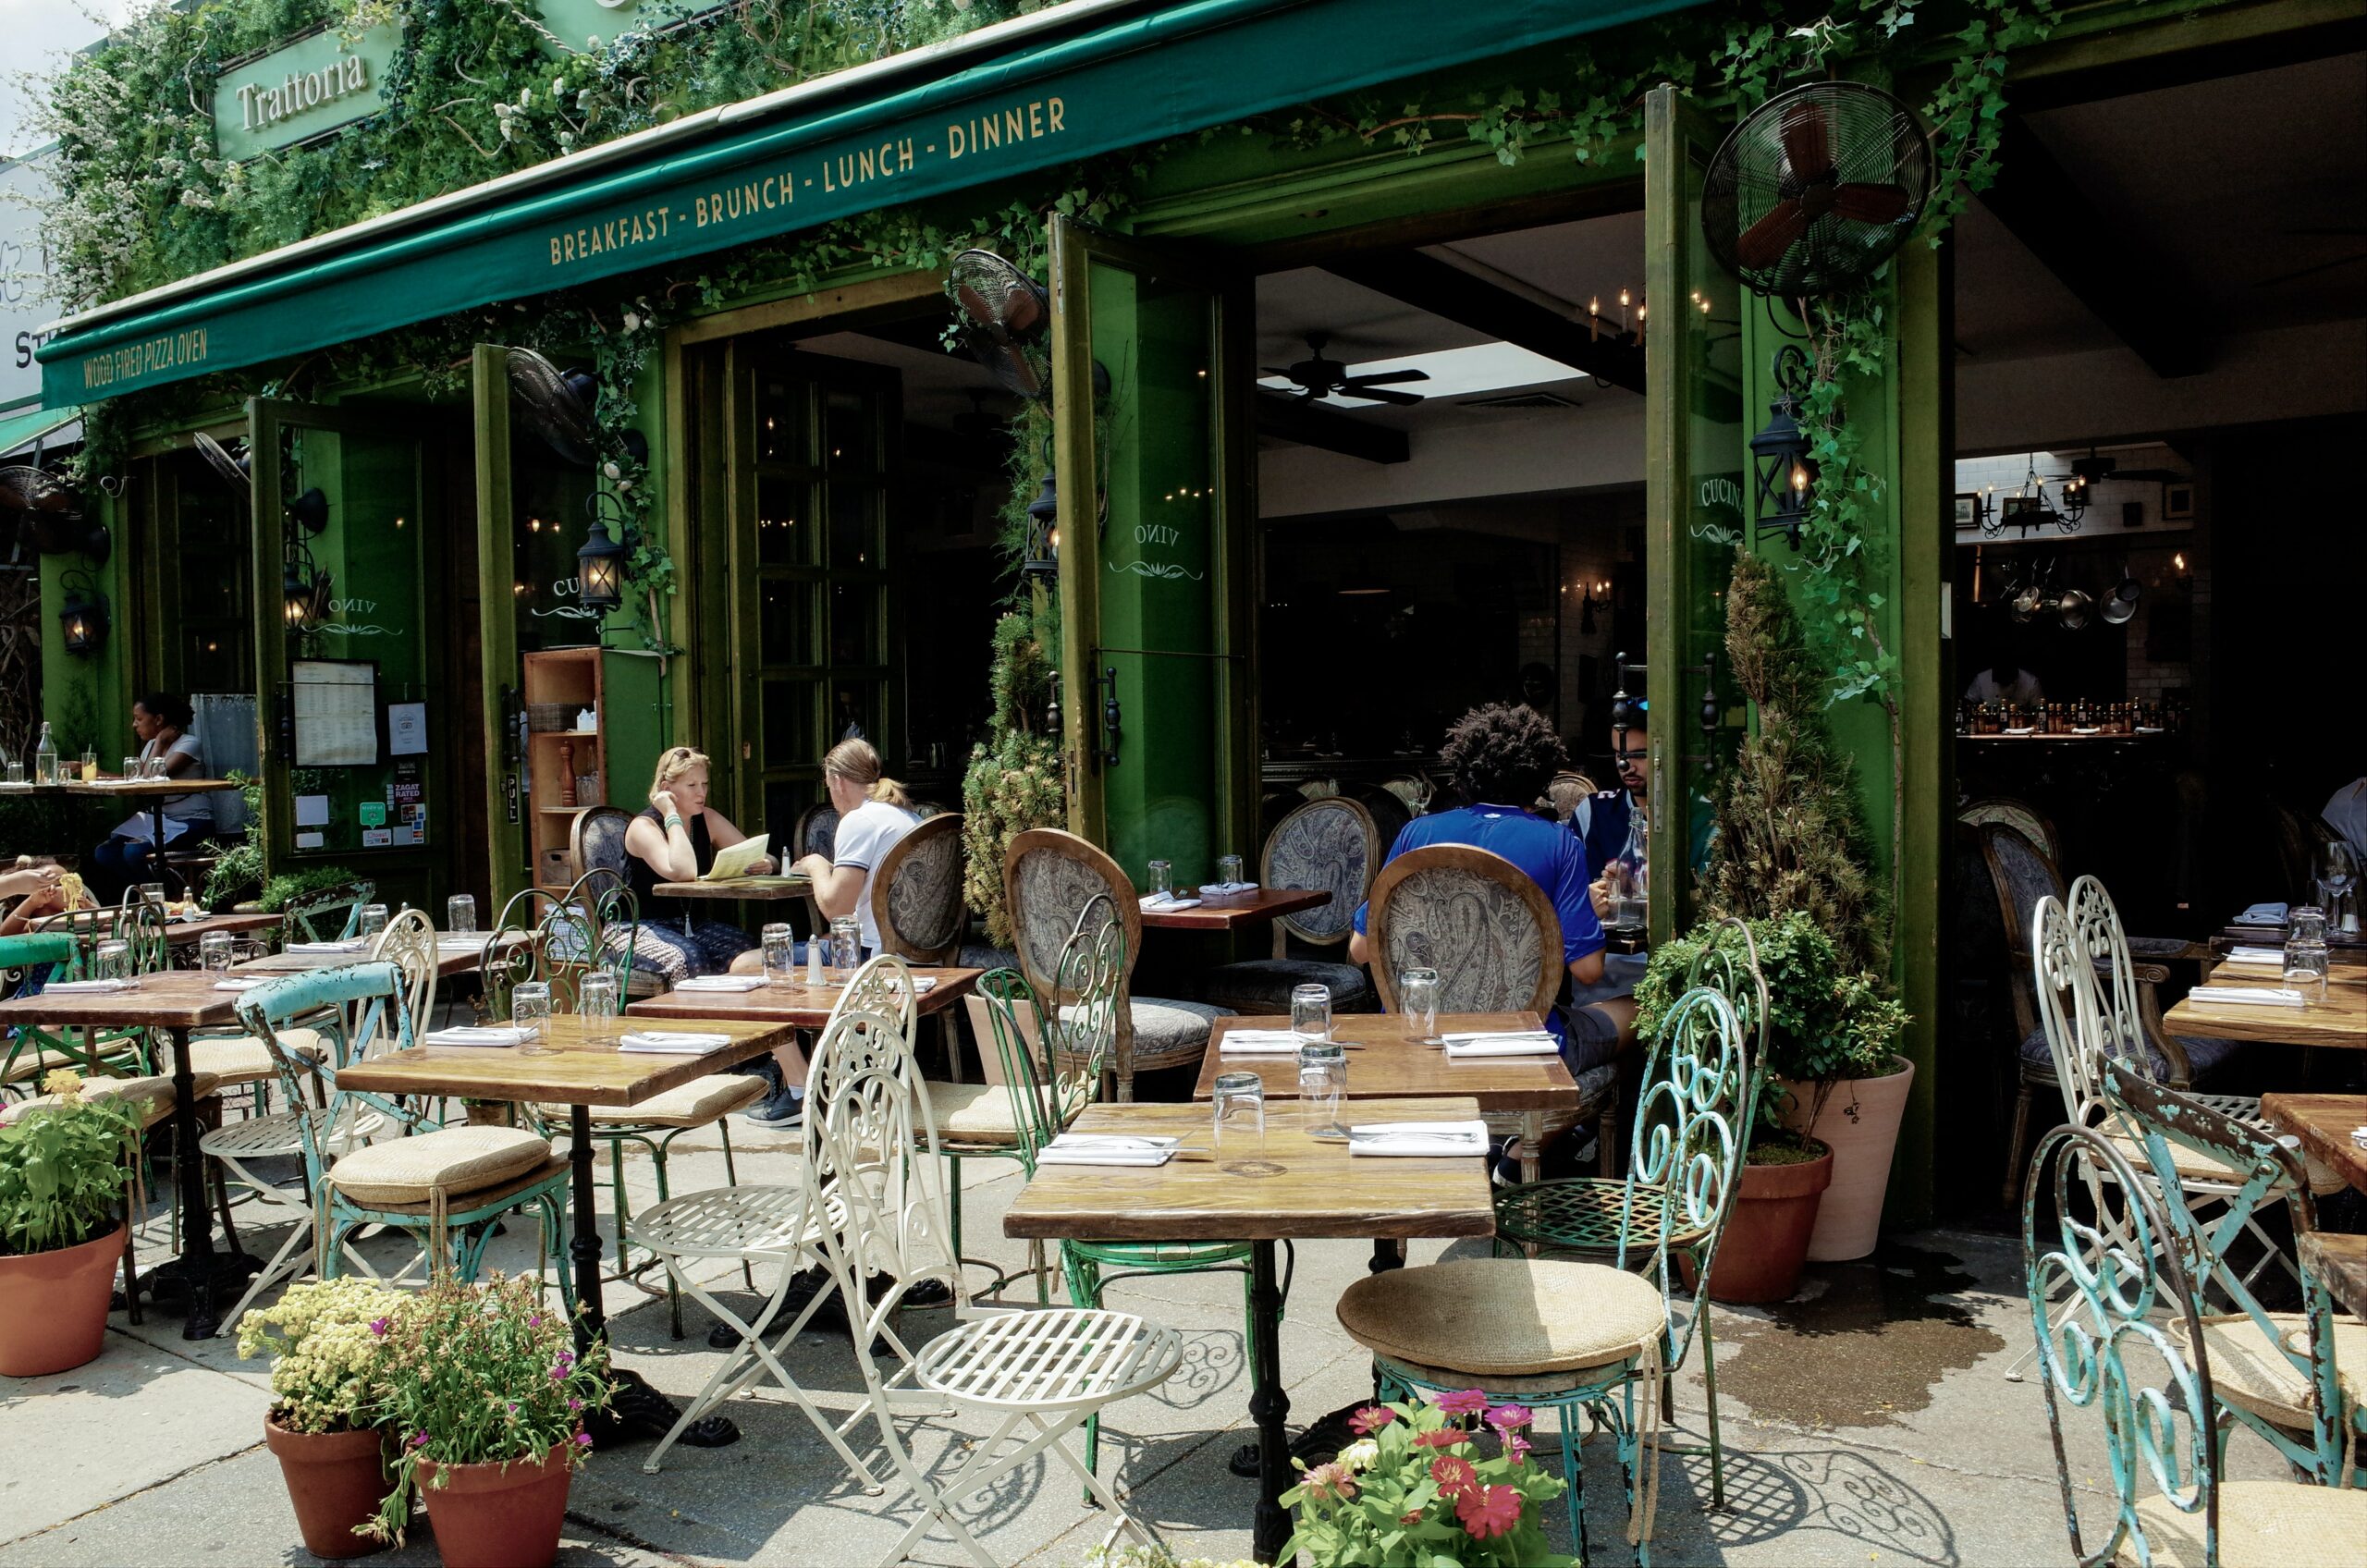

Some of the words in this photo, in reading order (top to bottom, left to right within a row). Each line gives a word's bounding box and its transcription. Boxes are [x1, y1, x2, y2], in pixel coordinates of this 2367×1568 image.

[236, 45, 367, 131] Trattoria
[550, 207, 669, 265] BREAKFAST
[695, 172, 793, 227] BRUNCH
[824, 138, 914, 192] LUNCH
[949, 97, 1065, 159] DINNER
[84, 354, 114, 389] WOOD
[116, 344, 141, 381] FIRED
[145, 337, 174, 374] PIZZA
[178, 328, 207, 365] OVEN
[553, 577, 580, 596] CU
[509, 778, 517, 819] PULL
